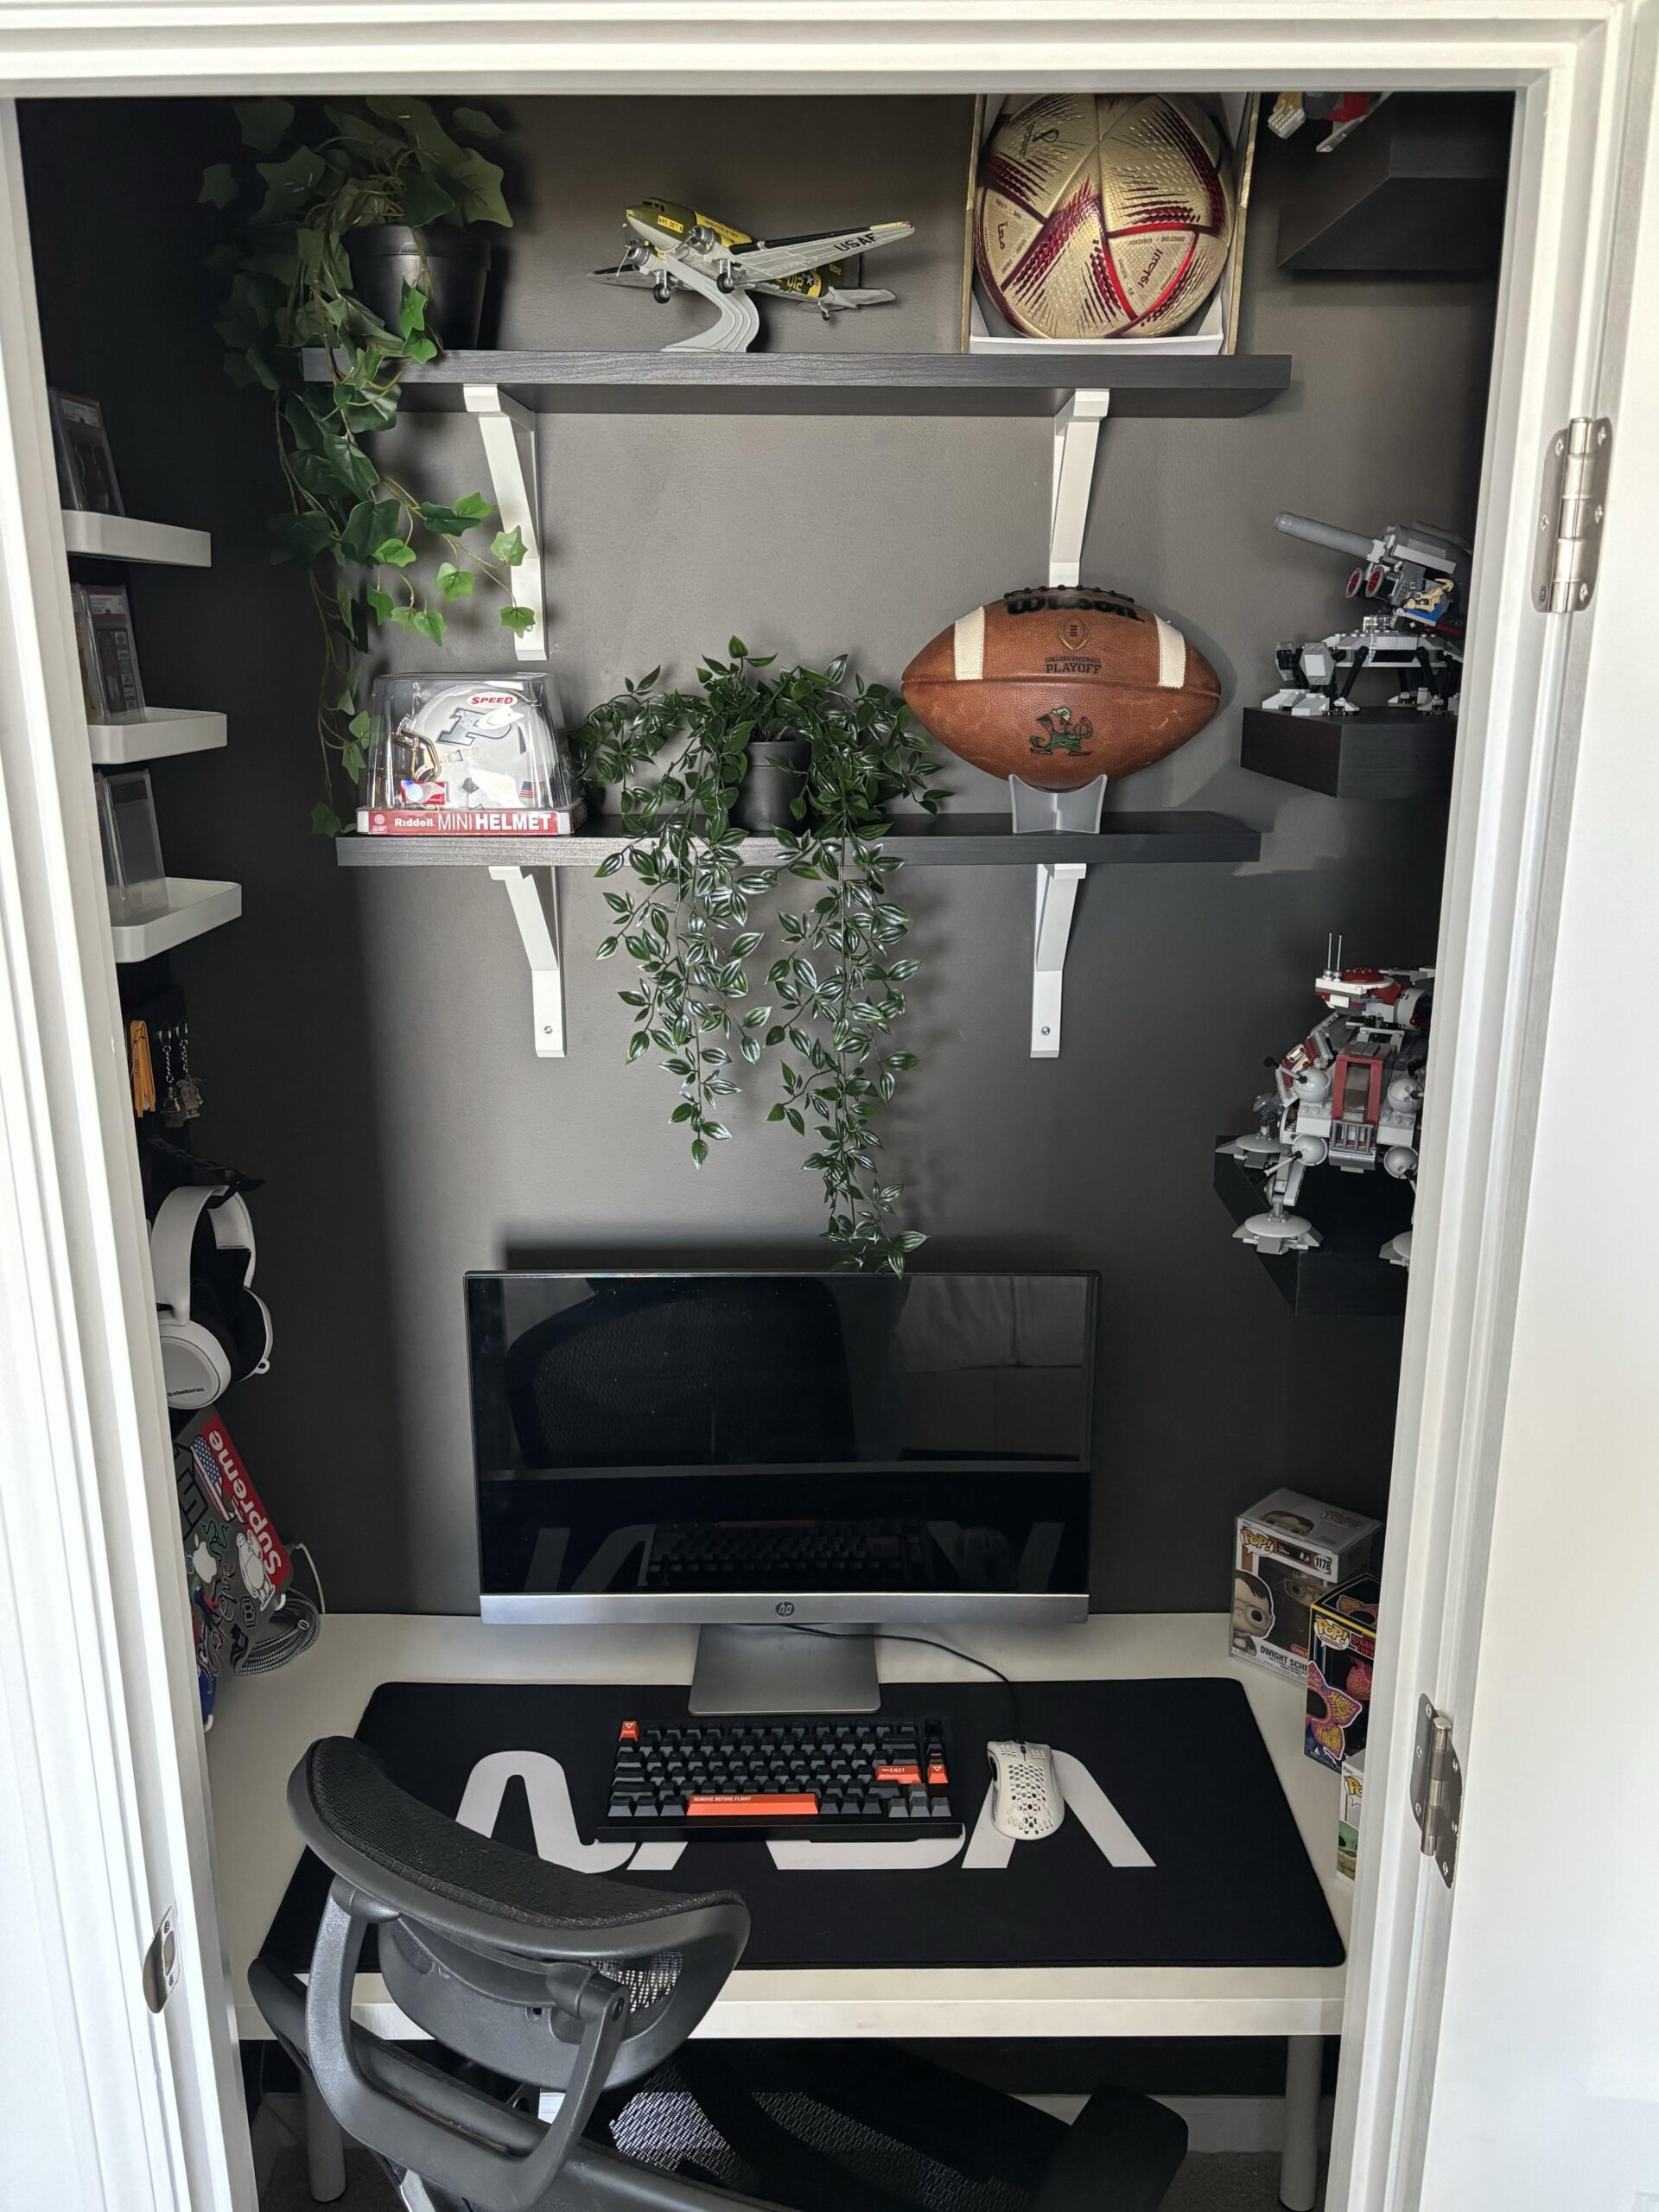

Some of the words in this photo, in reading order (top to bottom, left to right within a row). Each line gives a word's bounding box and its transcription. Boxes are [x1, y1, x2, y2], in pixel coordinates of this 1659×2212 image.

[834, 232, 876, 251] USAF
[1137, 248, 1164, 289] التطور
[1046, 663, 1102, 674] PLAYOFF
[470, 696, 513, 705] SPEED
[394, 817, 434, 827] Riddell
[438, 814, 473, 830] MINI
[475, 813, 551, 830] HELMET
[208, 1430, 282, 1575] Supreme
[1240, 1529, 1273, 1552] POP!
[1315, 1557, 1331, 1571] 1178
[778, 1602, 793, 1617] hp
[1315, 1617, 1349, 1644] POP!
[1260, 1645, 1288, 1663] DWIGHT
